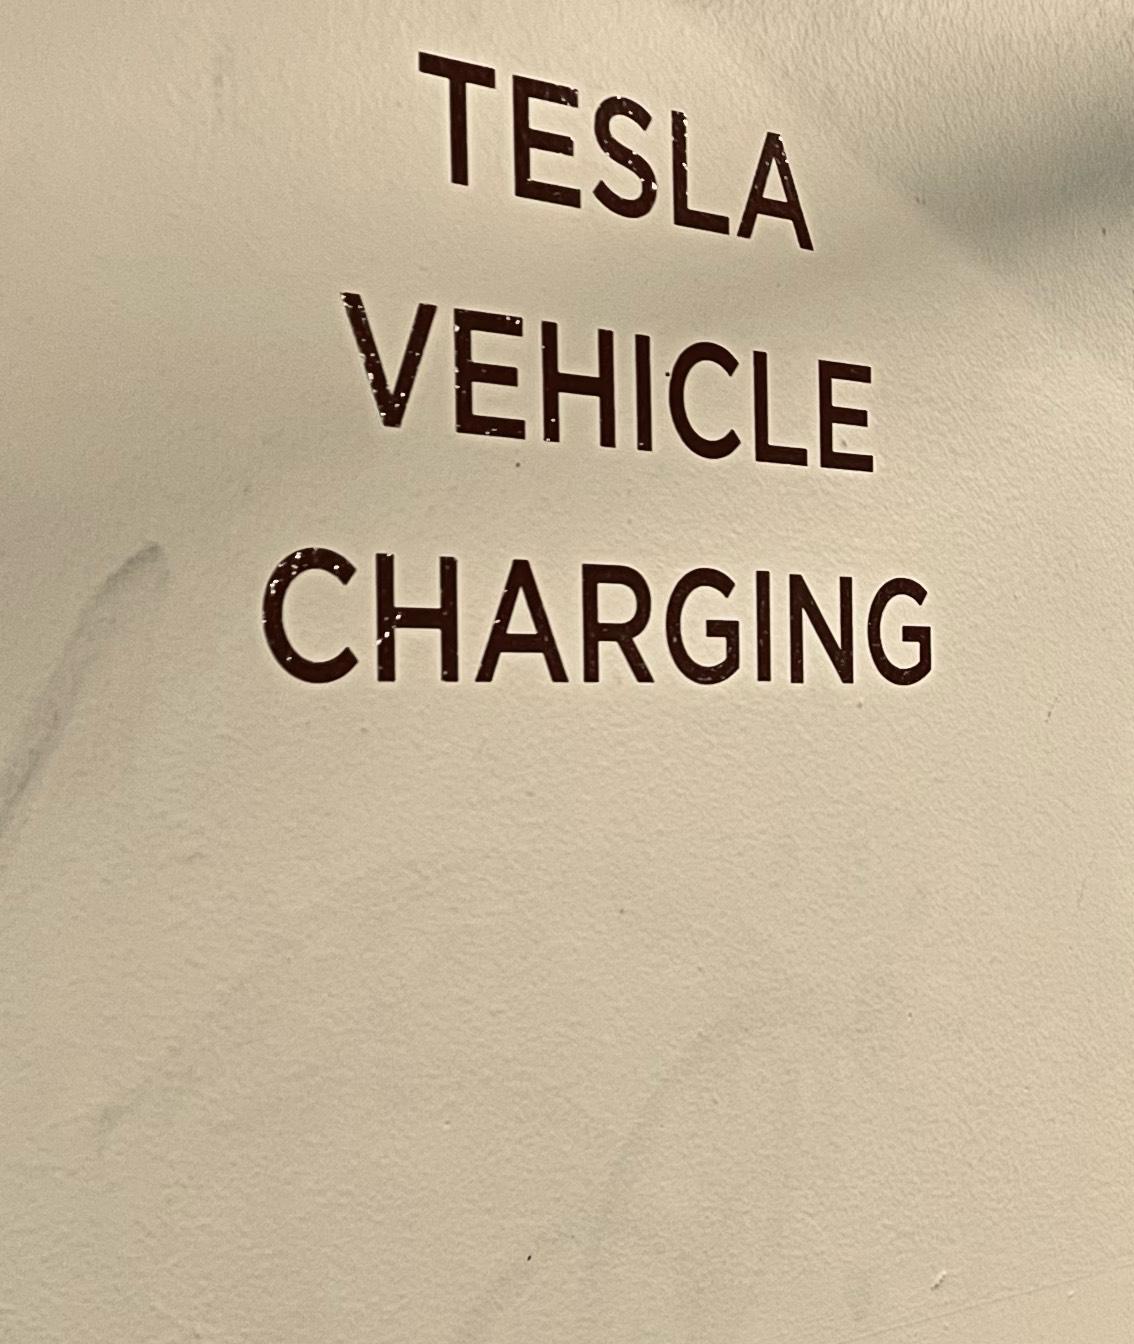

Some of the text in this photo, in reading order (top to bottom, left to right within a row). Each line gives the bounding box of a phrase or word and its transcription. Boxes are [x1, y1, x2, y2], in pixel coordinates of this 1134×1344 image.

[418, 51, 814, 251] TESLA
[340, 292, 874, 473] VEHICLE
[262, 547, 932, 686] CHARGING
